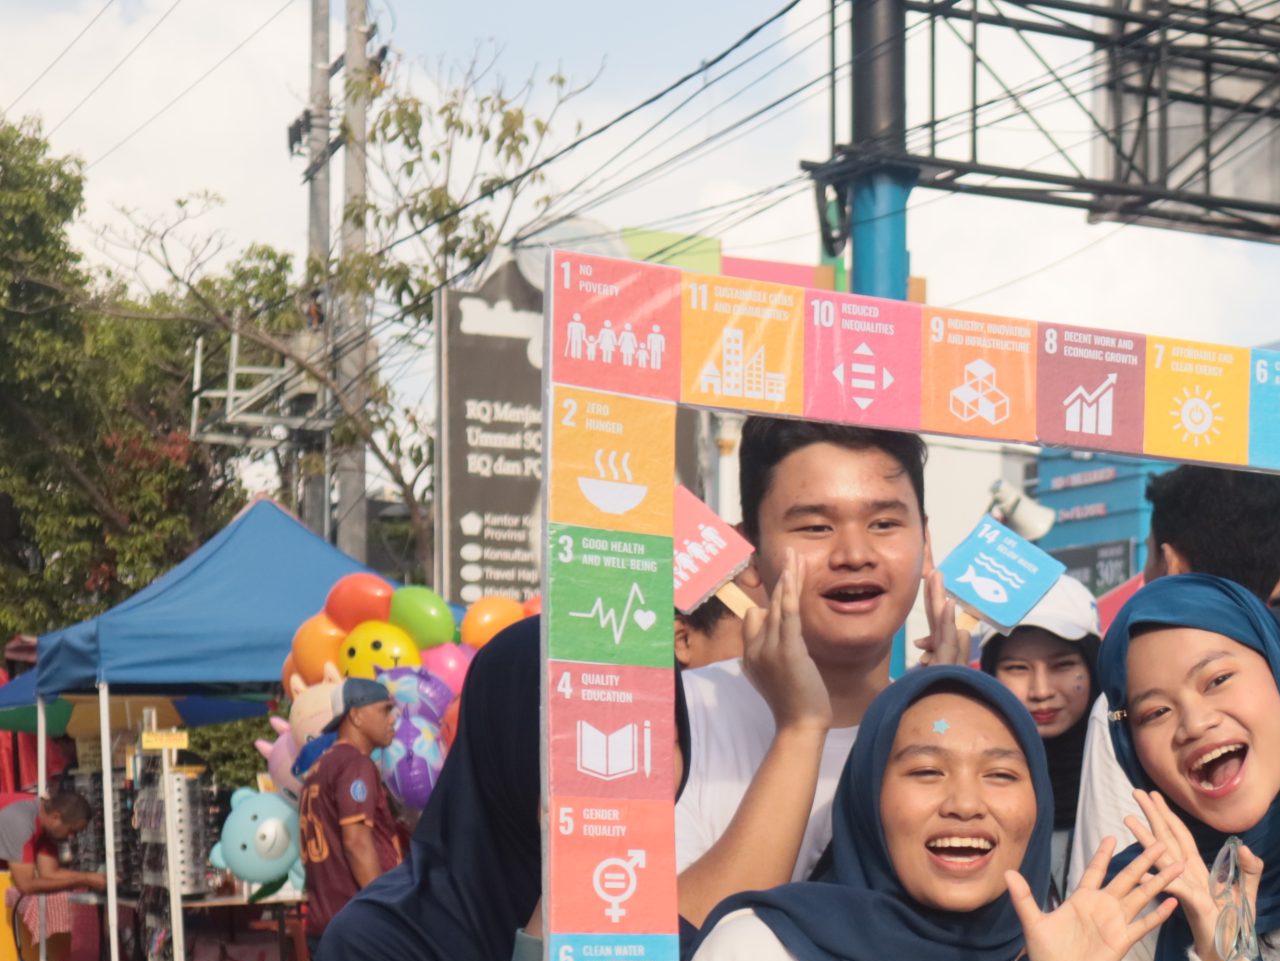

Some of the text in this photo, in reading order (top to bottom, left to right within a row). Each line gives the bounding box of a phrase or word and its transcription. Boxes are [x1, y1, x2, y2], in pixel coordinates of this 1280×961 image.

[561, 261, 571, 288] 1
[579, 264, 592, 276] NO
[579, 280, 620, 296] POVERTY
[688, 282, 708, 311] 11
[713, 302, 730, 313] AND
[810, 298, 835, 328] 10
[841, 303, 880, 318] REDUCED
[841, 318, 895, 336] INEQUALITIES
[930, 316, 945, 342] 9
[986, 323, 1032, 338] INNOVATION
[947, 333, 1030, 352] AND INFRASTRUCTURE
[1044, 328, 1058, 354] 8
[1064, 330, 1134, 350] DECENT WORK AND
[1063, 345, 1138, 366] ECONOMIC GROWTH
[1154, 343, 1165, 369] 7
[1171, 345, 1234, 364] AFFORDABLE AND
[1171, 361, 1223, 377] CLEAN ENERGY
[1256, 359, 1268, 384] 6
[562, 399, 577, 427] 2
[586, 402, 610, 416] ZERO
[585, 417, 624, 434] HUNGER
[493, 455, 523, 475] dan
[484, 513, 519, 527] Kantor
[484, 528, 525, 541] Provinsi
[978, 523, 1000, 544] 14
[1003, 537, 1018, 548] LIFE
[558, 534, 574, 563] 3
[582, 537, 646, 555] GOOD HEALTH
[582, 554, 658, 572] AND WELL-BEING
[485, 567, 515, 580] Travel
[557, 672, 573, 699] 4
[581, 673, 620, 686] QUALITY
[582, 690, 633, 703] EDUCATION
[559, 807, 574, 835] 5
[583, 808, 620, 820] GENDER
[583, 824, 626, 837] EQUALITY
[582, 945, 645, 956] CLEAN WATER
